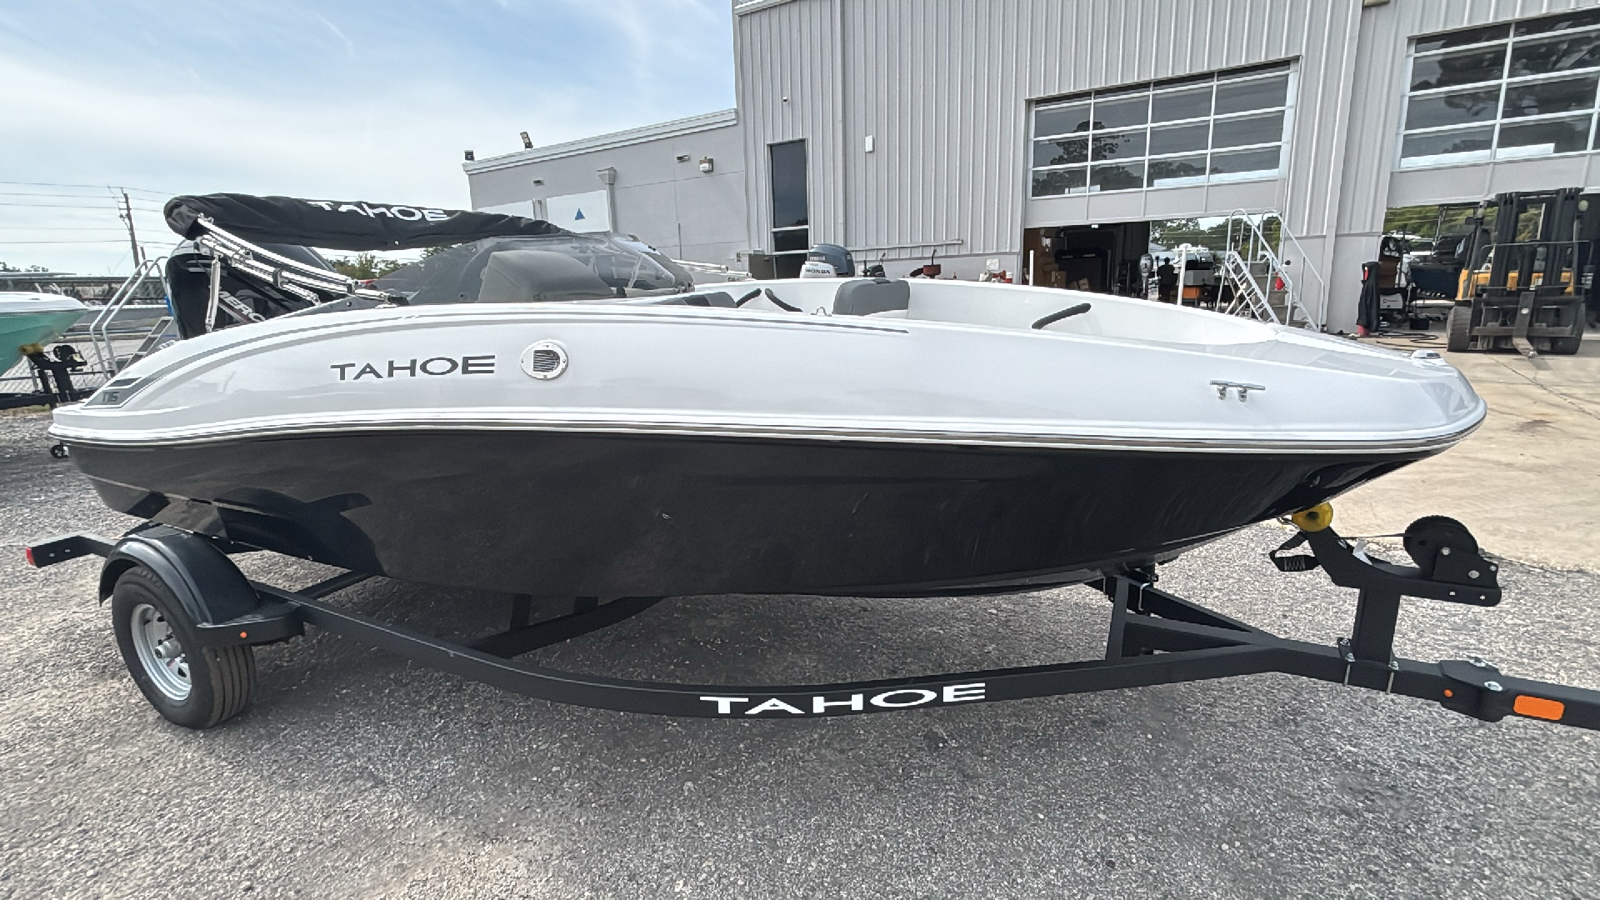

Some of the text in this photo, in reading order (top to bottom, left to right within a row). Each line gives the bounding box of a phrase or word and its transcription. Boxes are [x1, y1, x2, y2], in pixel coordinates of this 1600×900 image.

[307, 201, 449, 221] TAHOE
[330, 355, 496, 381] TAHOE
[700, 683, 986, 714] TAHOE
